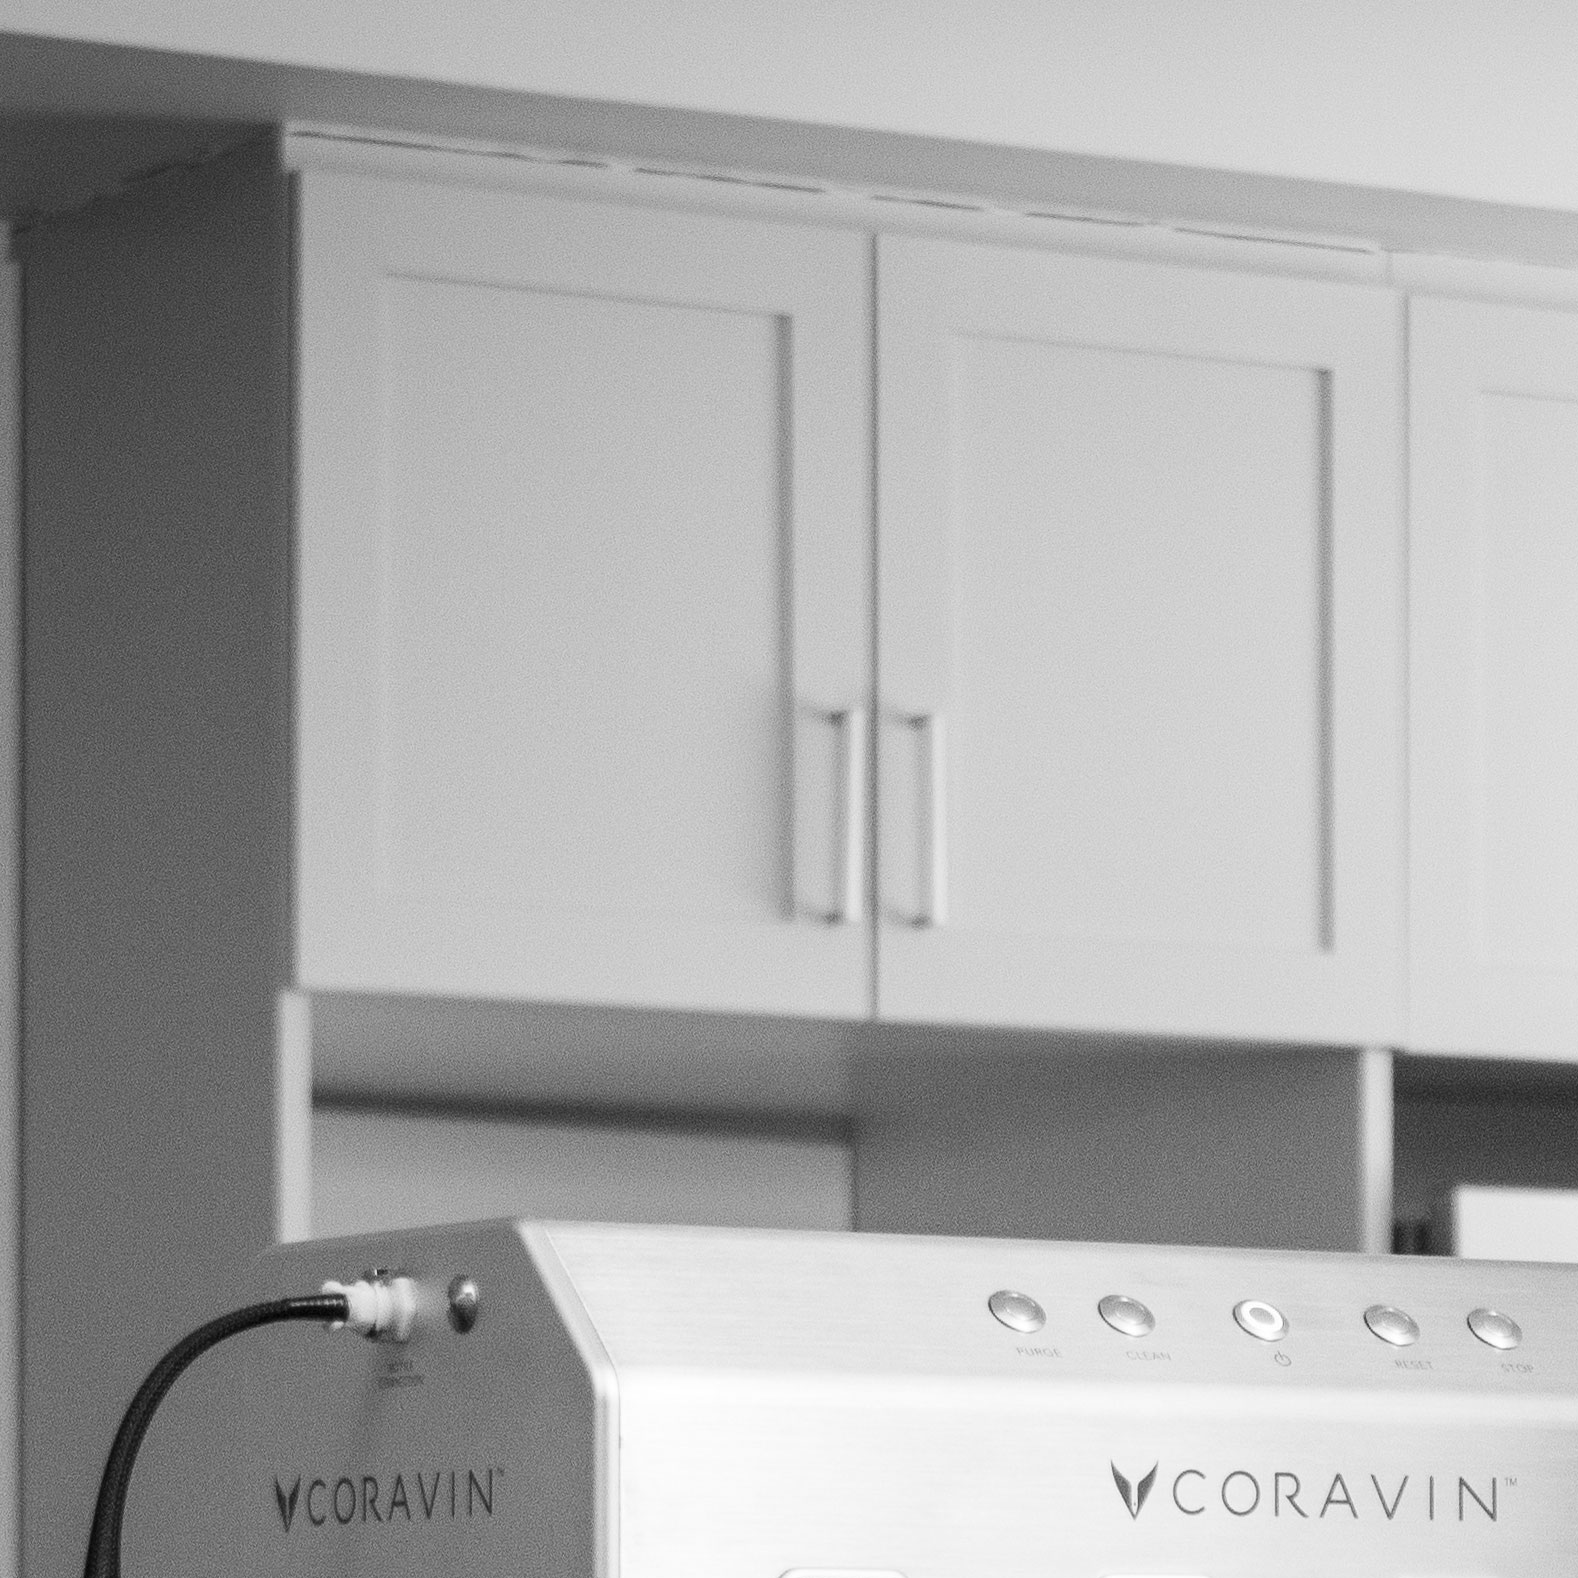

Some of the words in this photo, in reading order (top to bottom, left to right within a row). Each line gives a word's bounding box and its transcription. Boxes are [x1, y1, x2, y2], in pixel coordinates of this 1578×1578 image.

[1015, 1346, 1063, 1359] PURGE
[1125, 1350, 1172, 1361] CLEAN
[1393, 1359, 1434, 1371] RESET
[1500, 1362, 1534, 1374] STOP
[307, 1469, 493, 1527] CORAVIN
[1172, 1469, 1497, 1522] CORAVIN
